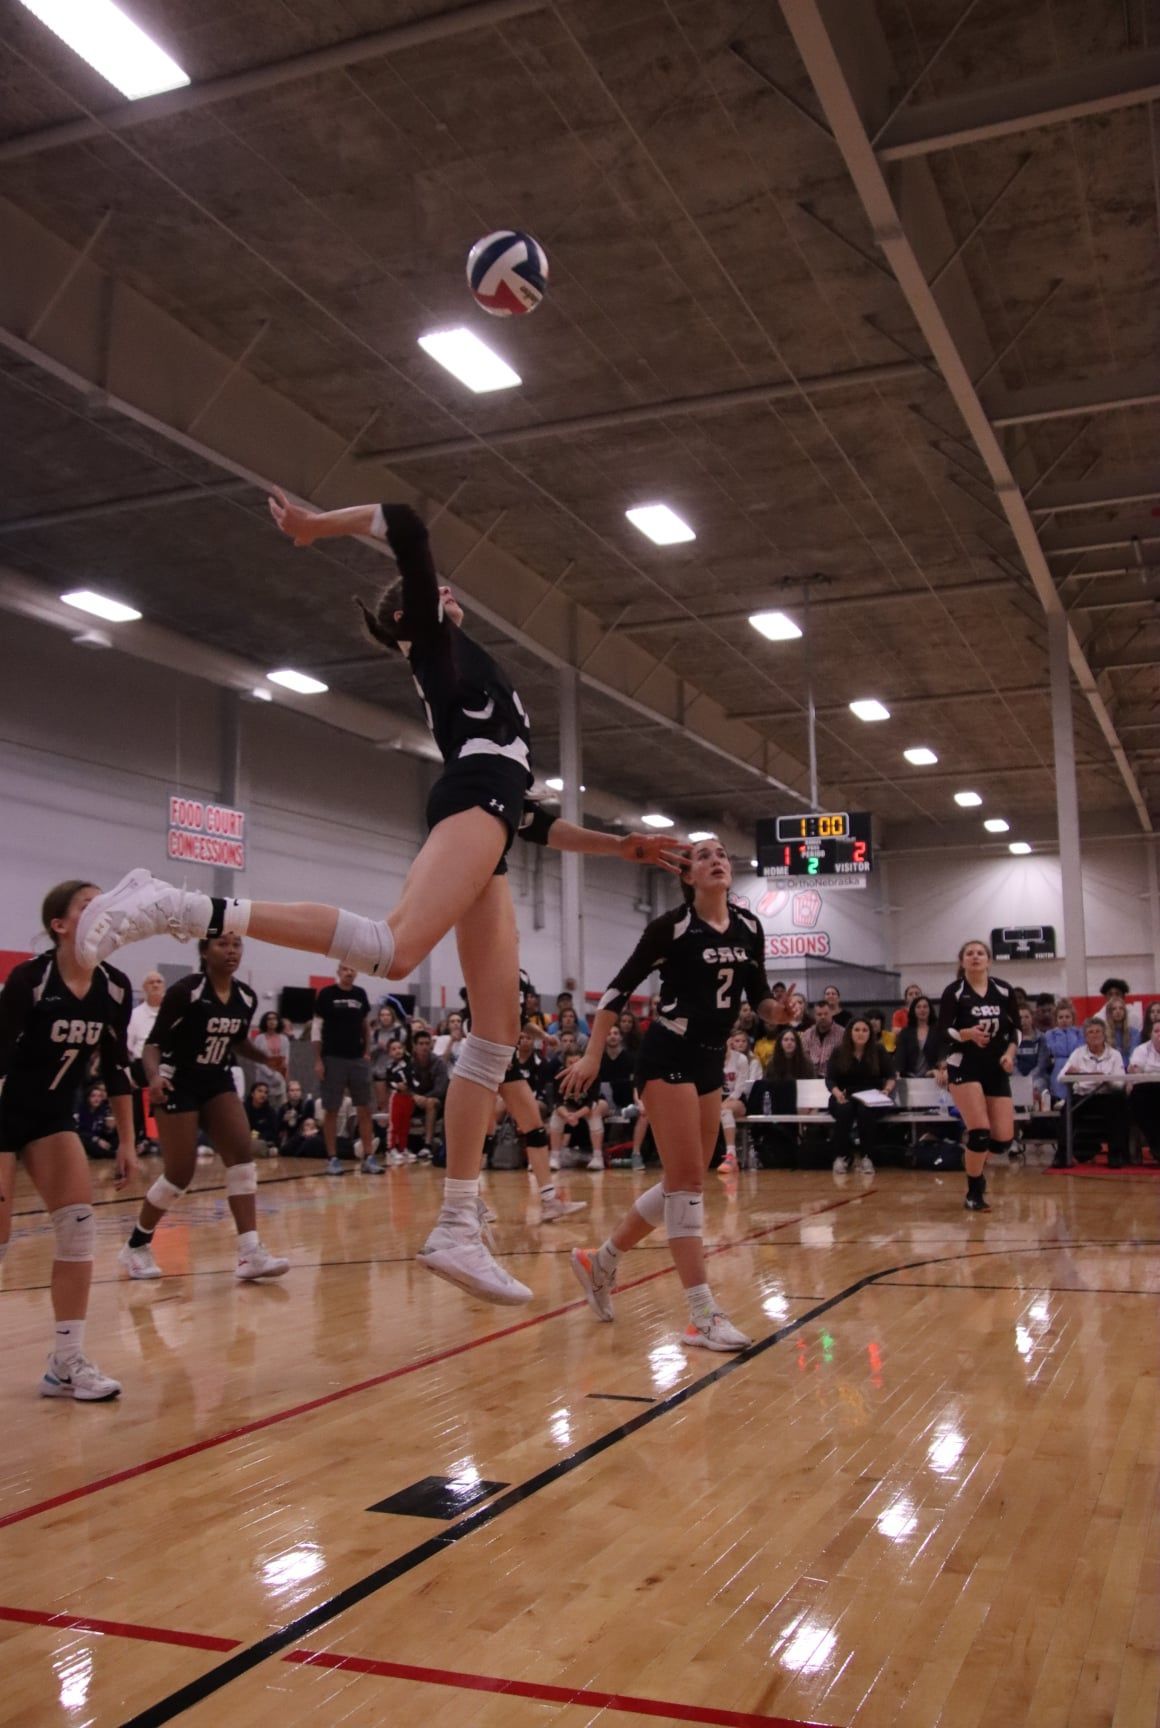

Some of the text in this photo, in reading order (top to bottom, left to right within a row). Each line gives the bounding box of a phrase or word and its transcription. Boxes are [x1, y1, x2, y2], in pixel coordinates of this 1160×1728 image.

[170, 797, 244, 839] FOOD COURT
[800, 815, 843, 837] 1:00
[168, 830, 244, 869] CONCESSIONS
[784, 845, 792, 867] 1
[853, 841, 867, 862] 2
[763, 866, 789, 876] HOME
[808, 857, 819, 875] 2
[835, 862, 870, 873] VISITOR
[716, 968, 735, 1009] 2
[971, 1005, 1001, 1017] CRU
[50, 1019, 103, 1045] CRU
[206, 1017, 242, 1034] CRU
[196, 1036, 231, 1065] 30
[48, 1048, 79, 1090] 7
